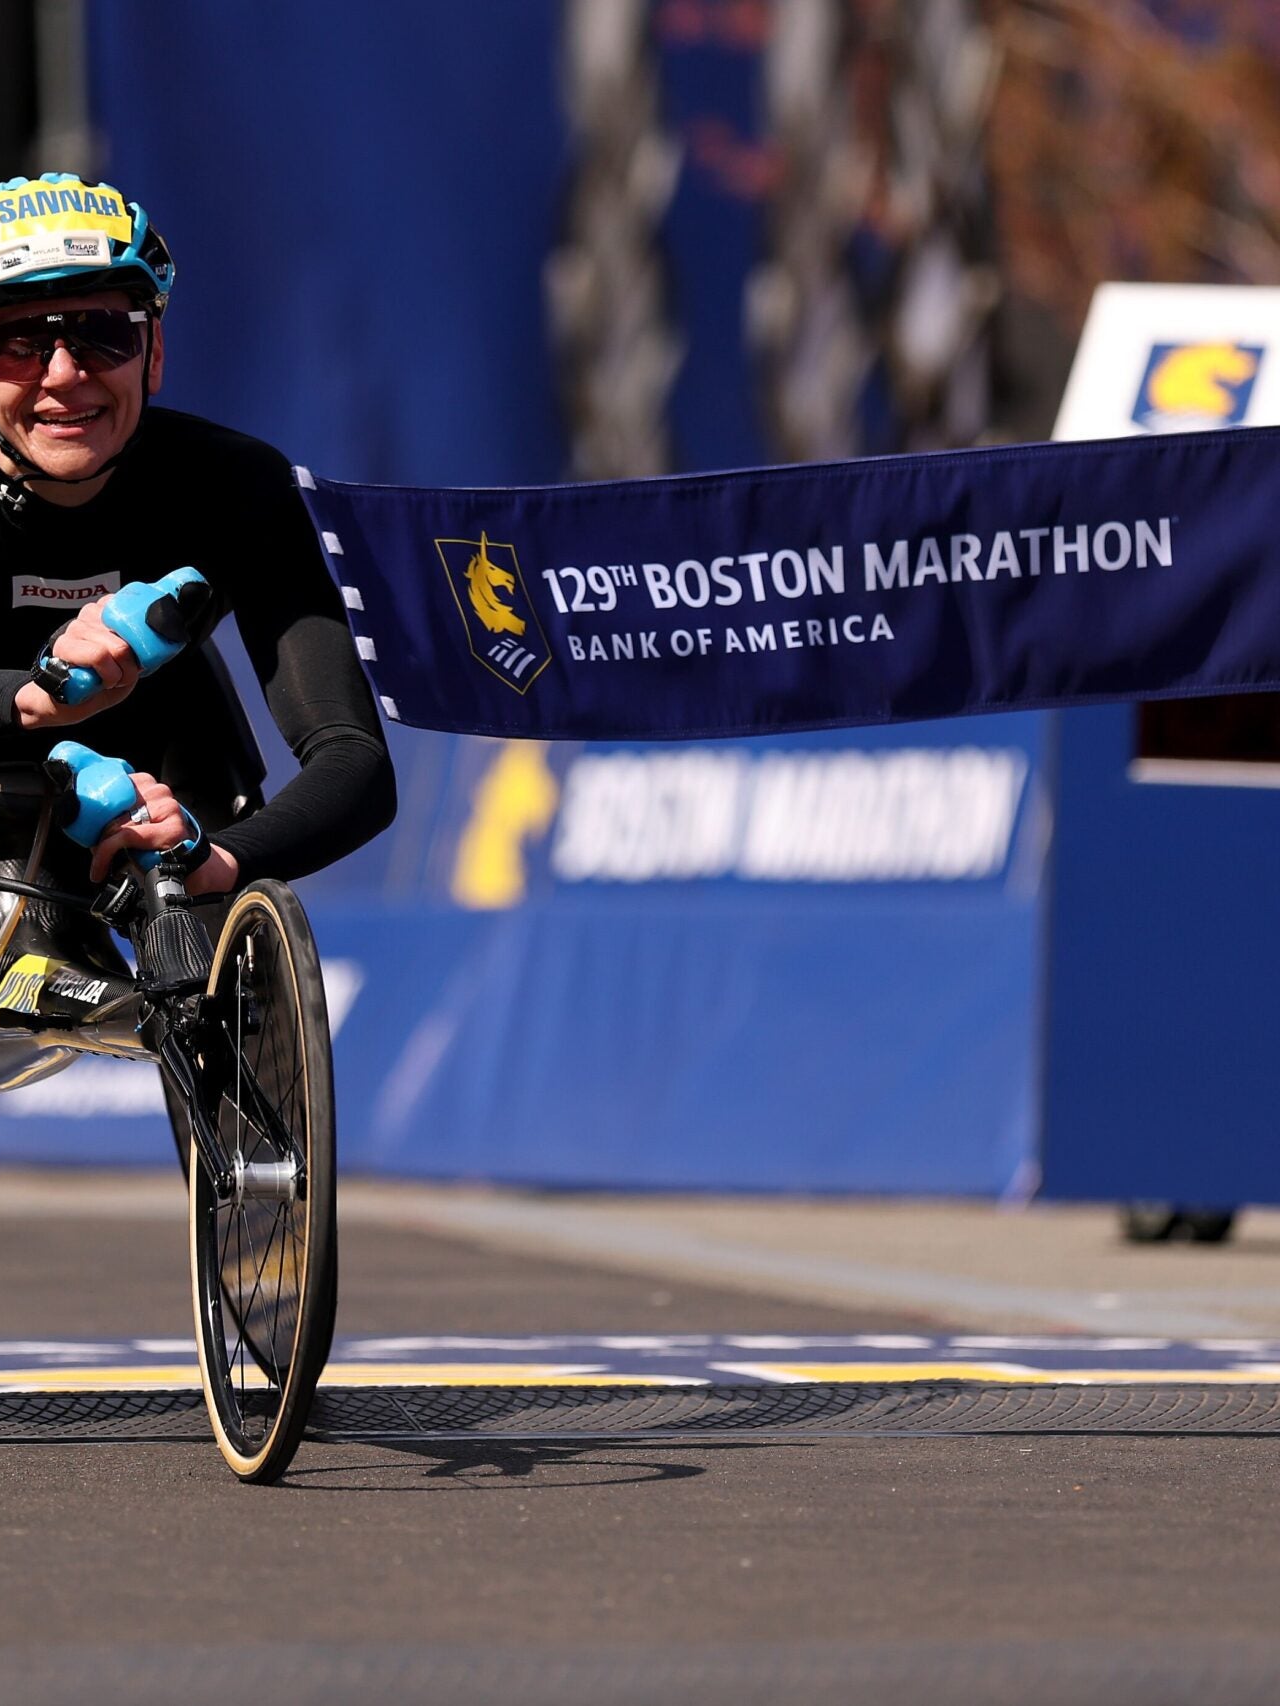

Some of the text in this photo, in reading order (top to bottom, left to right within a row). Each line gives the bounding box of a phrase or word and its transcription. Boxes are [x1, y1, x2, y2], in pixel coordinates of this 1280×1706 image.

[33, 246, 61, 255] MYLAPS
[542, 517, 1173, 613] 129TH BOSTON MARATHON
[20, 584, 110, 600] HONDA
[566, 613, 895, 663] BANK OF AMERICA
[113, 884, 135, 913] GARMIN
[48, 972, 109, 1004] HONDA
